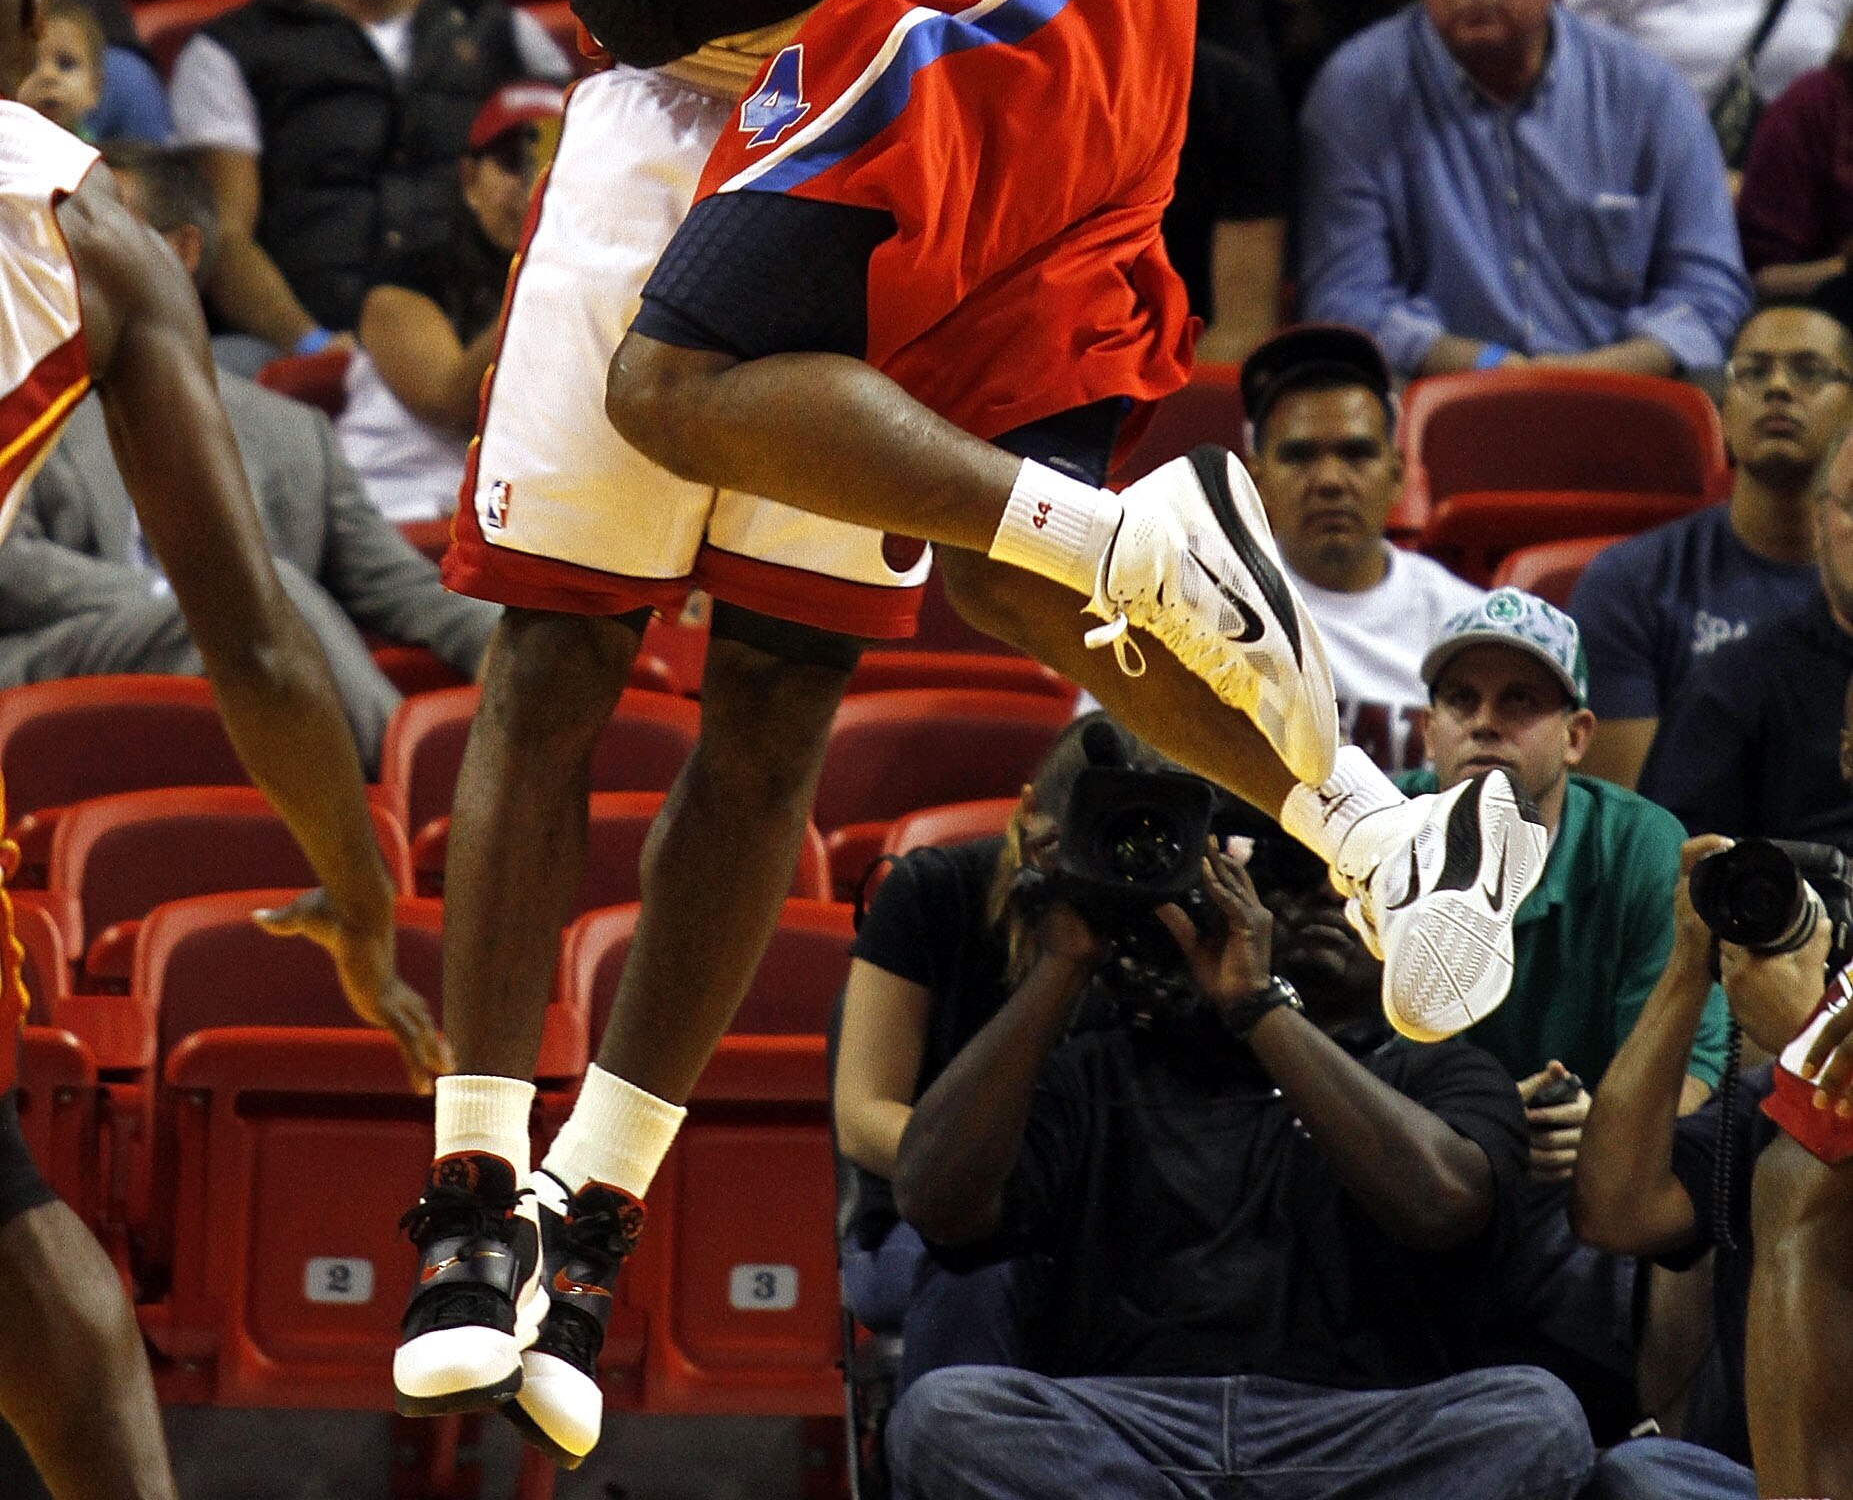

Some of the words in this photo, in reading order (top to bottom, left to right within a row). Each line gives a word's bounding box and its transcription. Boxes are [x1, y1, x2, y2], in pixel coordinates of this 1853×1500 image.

[738, 42, 812, 150] 4
[1032, 501, 1052, 530] 44
[326, 1265, 351, 1293] 2
[753, 1271, 777, 1300] 3
